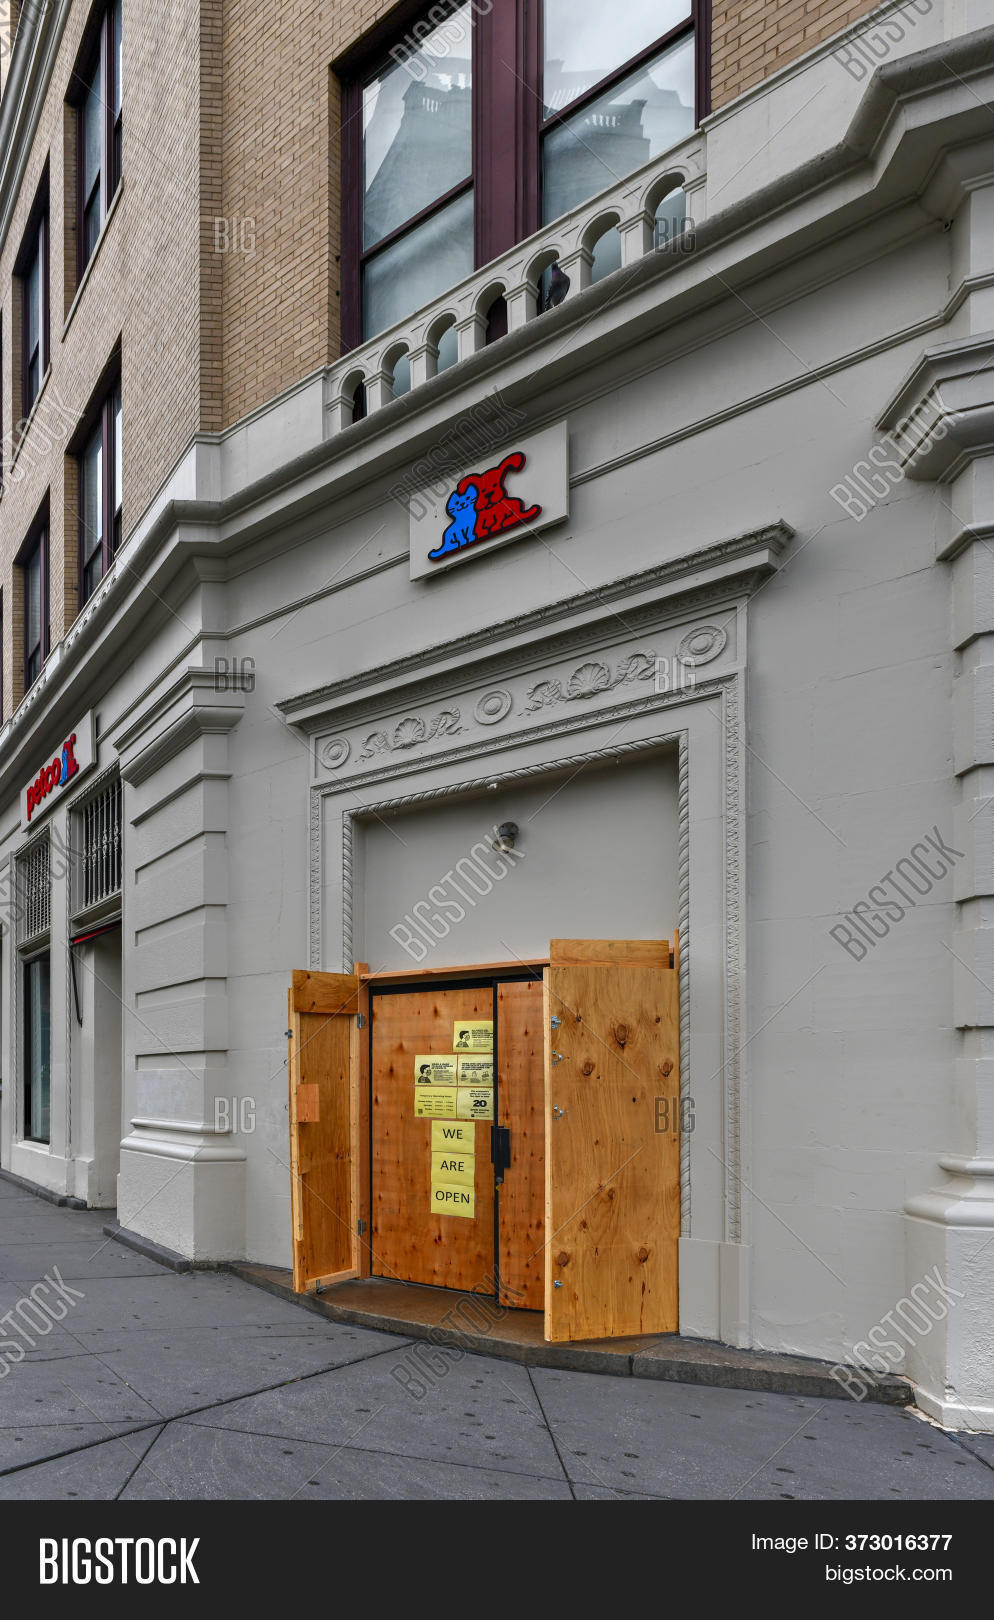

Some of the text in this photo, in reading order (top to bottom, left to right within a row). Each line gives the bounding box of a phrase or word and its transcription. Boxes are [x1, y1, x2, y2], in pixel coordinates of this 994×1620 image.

[26, 757, 62, 822] petco
[472, 1099, 488, 1108] 20
[442, 1128, 463, 1140] WE
[440, 1160, 465, 1172] ARE
[435, 1190, 470, 1204] OPEN
